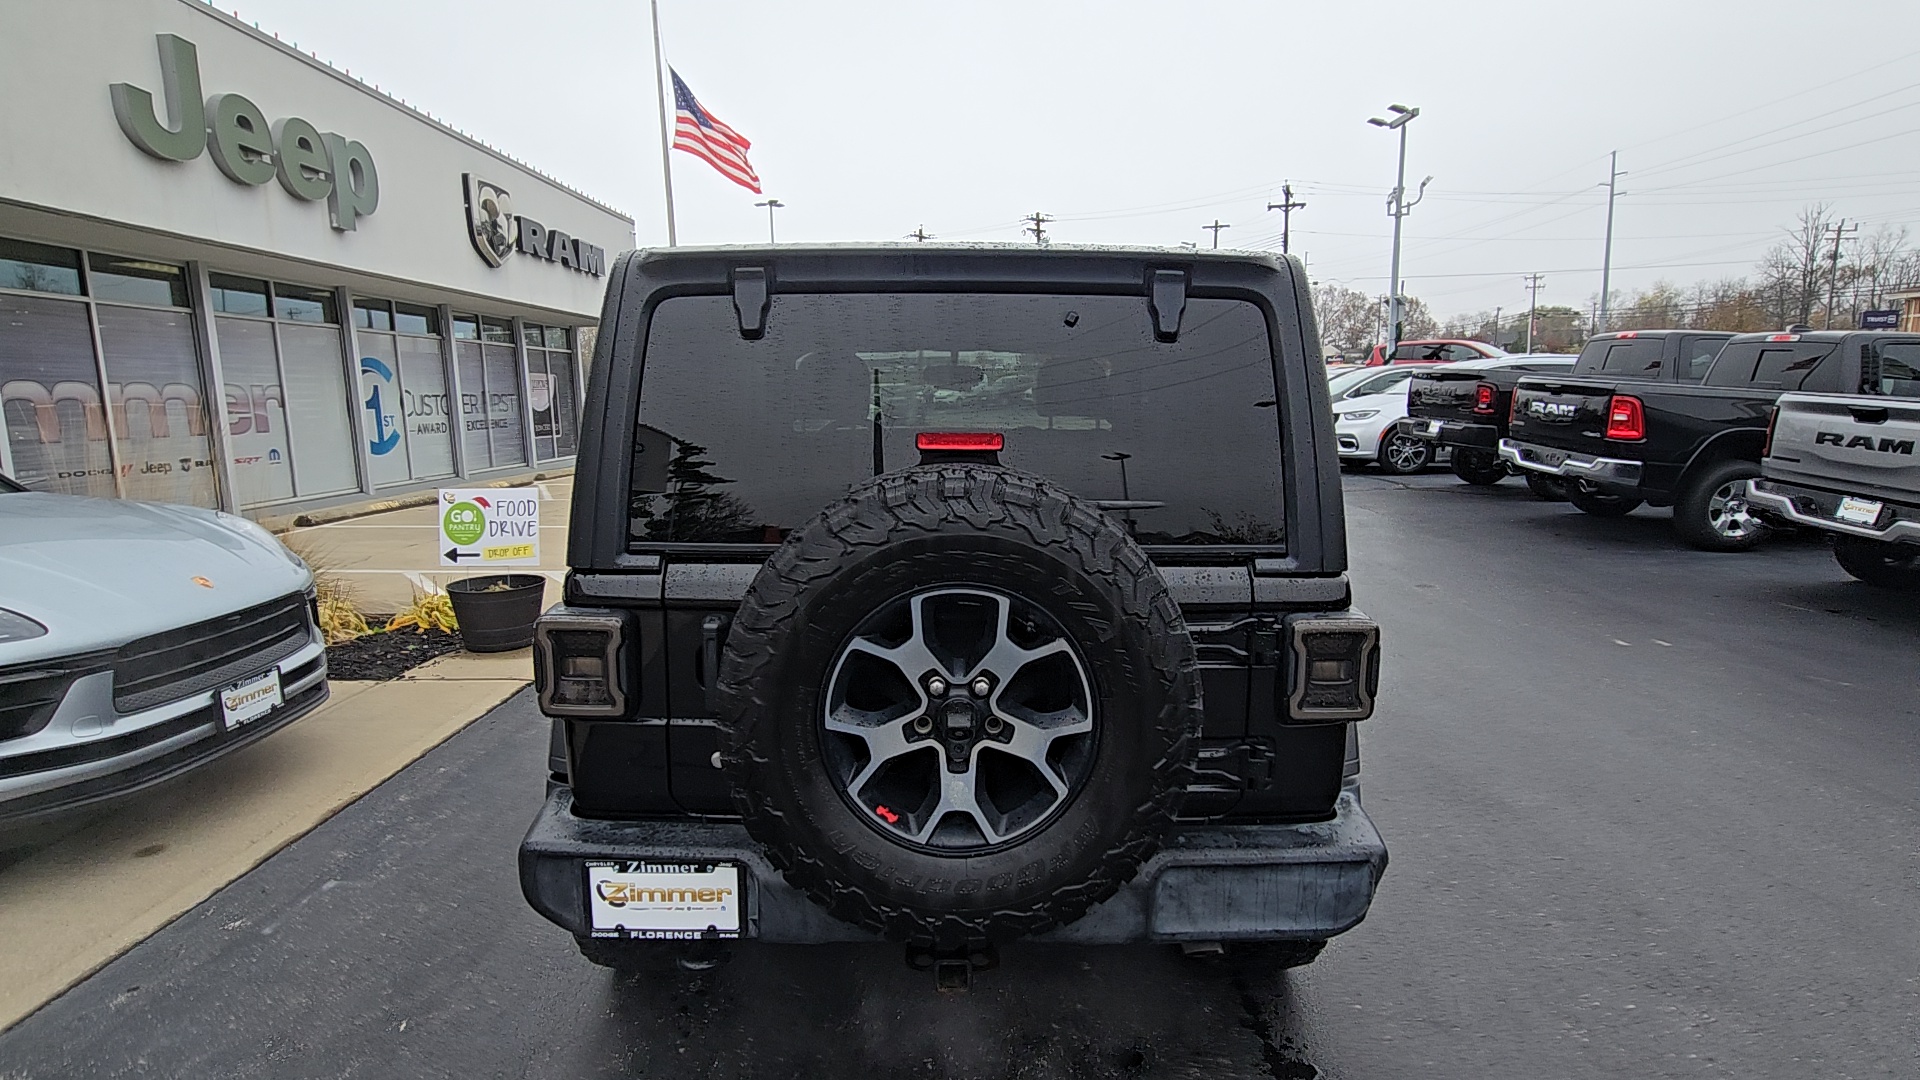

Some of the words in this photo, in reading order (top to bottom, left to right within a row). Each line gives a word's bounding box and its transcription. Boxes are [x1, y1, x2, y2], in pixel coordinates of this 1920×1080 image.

[109, 33, 379, 232] Jeep
[514, 215, 606, 278] RAM
[404, 389, 479, 417] CUSTOER
[1530, 401, 1577, 417] RAM
[416, 422, 448, 435] AWARD
[466, 418, 508, 431] EXCELENCE
[1815, 431, 1915, 455] RAM
[58, 468, 114, 478] DODG
[140, 460, 172, 474] Jeep
[450, 509, 477, 523] GO!
[496, 499, 537, 517] FOOD
[489, 520, 537, 537] DRIVE
[487, 548, 510, 559] DROP
[512, 545, 530, 556] OFF
[225, 683, 278, 711] Zimmer
[627, 861, 699, 873] Zimmer
[604, 882, 733, 903] Zimmer
[631, 931, 702, 939] FLORENCE
